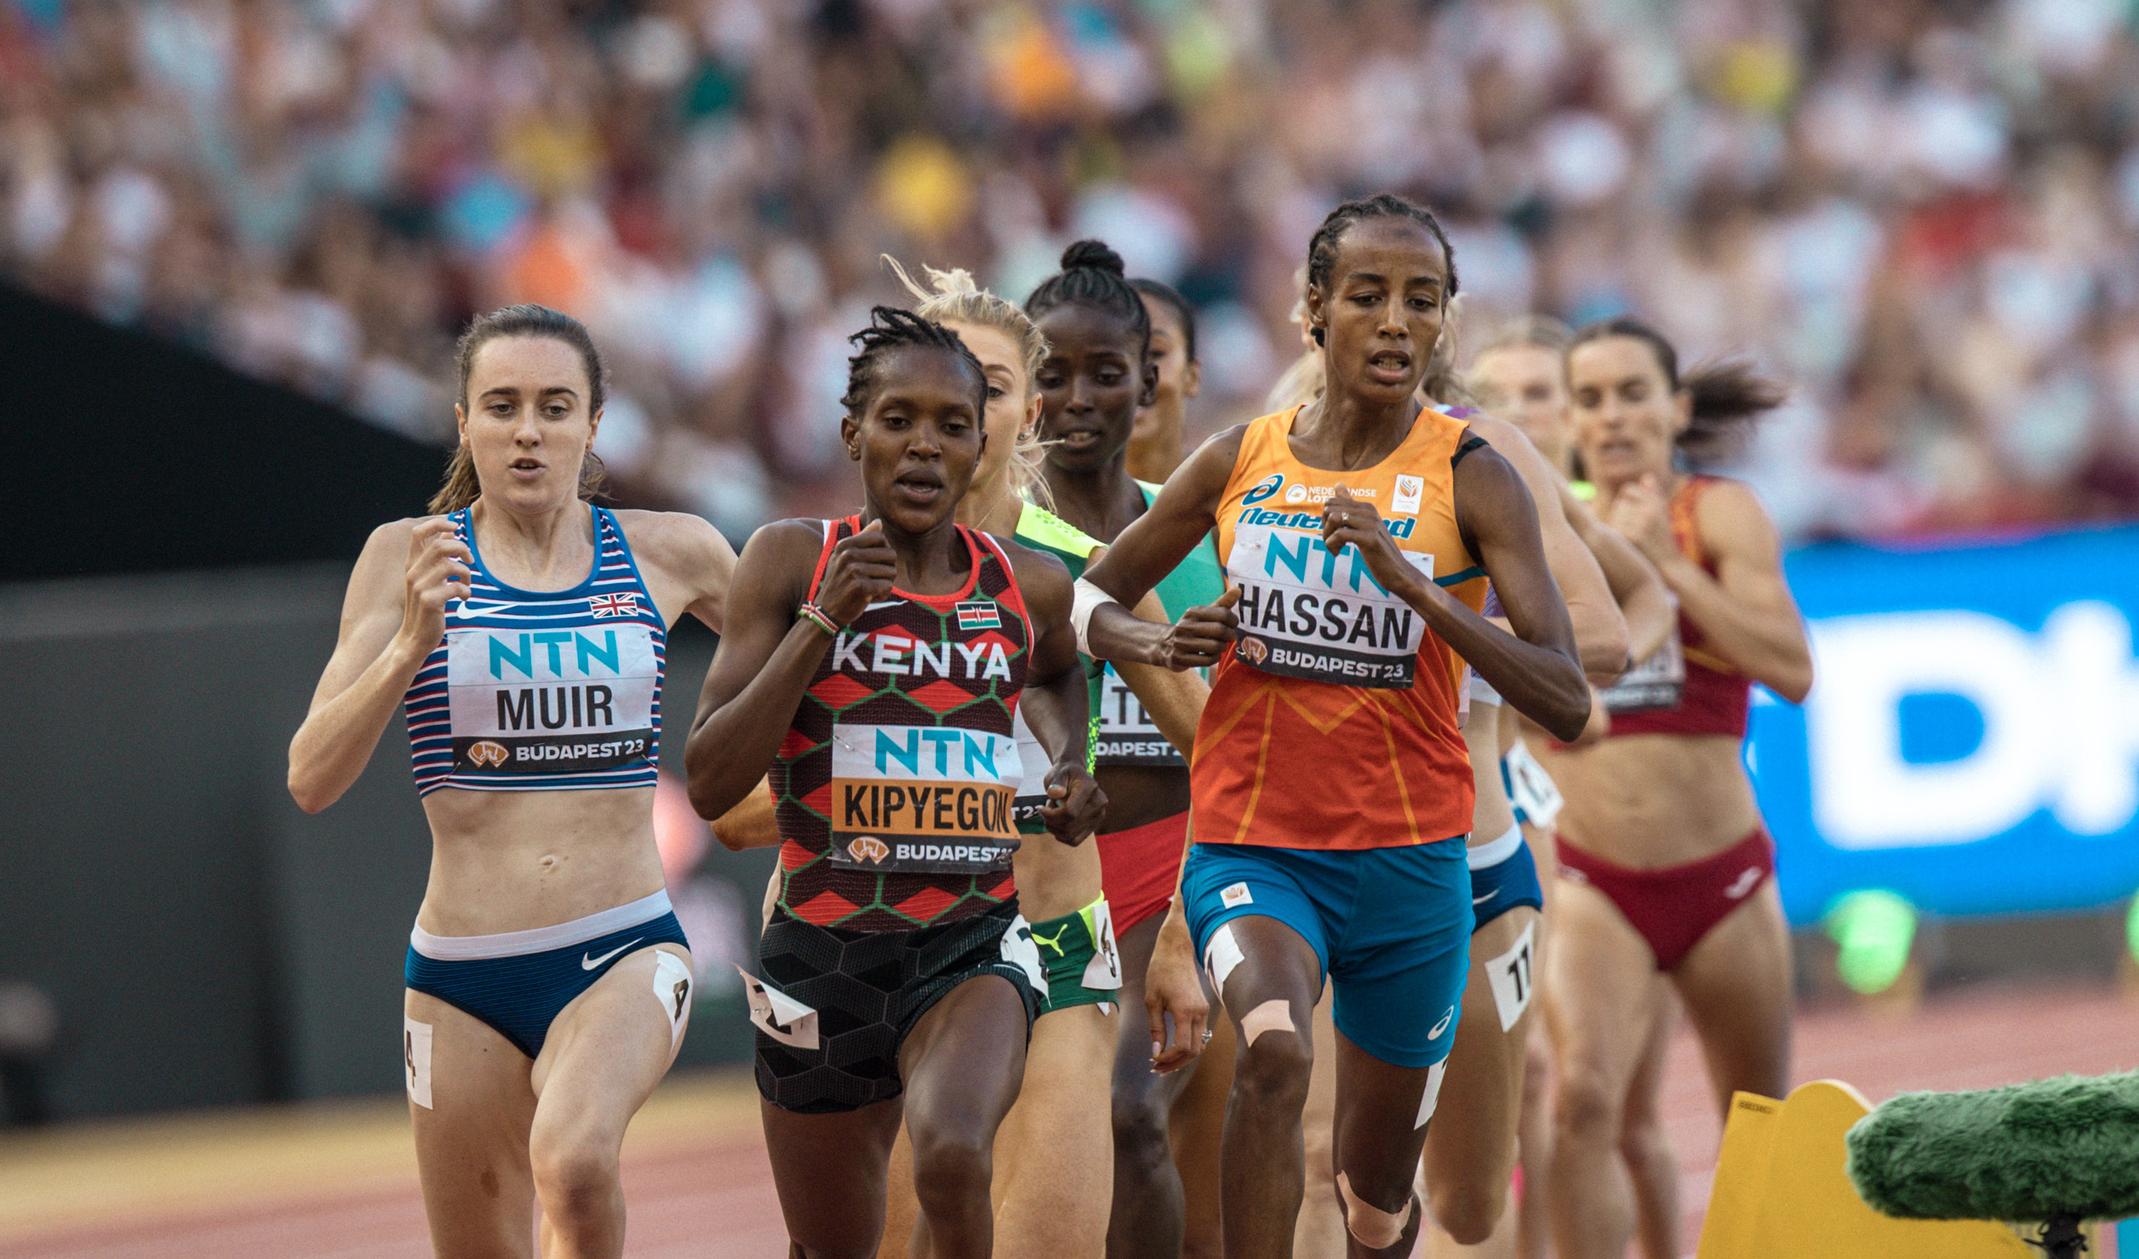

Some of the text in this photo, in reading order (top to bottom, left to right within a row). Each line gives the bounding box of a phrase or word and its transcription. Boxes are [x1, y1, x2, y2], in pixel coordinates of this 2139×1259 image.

[1308, 487, 1376, 498] NEDENDSE
[1264, 532, 1389, 597] NTN
[1238, 583, 1412, 649] HASSAN
[489, 630, 620, 680] NTN
[832, 632, 1011, 682] KENYA
[1272, 648, 1404, 678] BUDAPEST 23
[496, 685, 614, 730] MUIR
[516, 739, 645, 761] BUDAPEST 23
[875, 728, 999, 779] NTN
[1096, 742, 1172, 756] DAPEST
[845, 785, 1010, 833] KIPYEGON
[896, 844, 1000, 864] BUDAPEST
